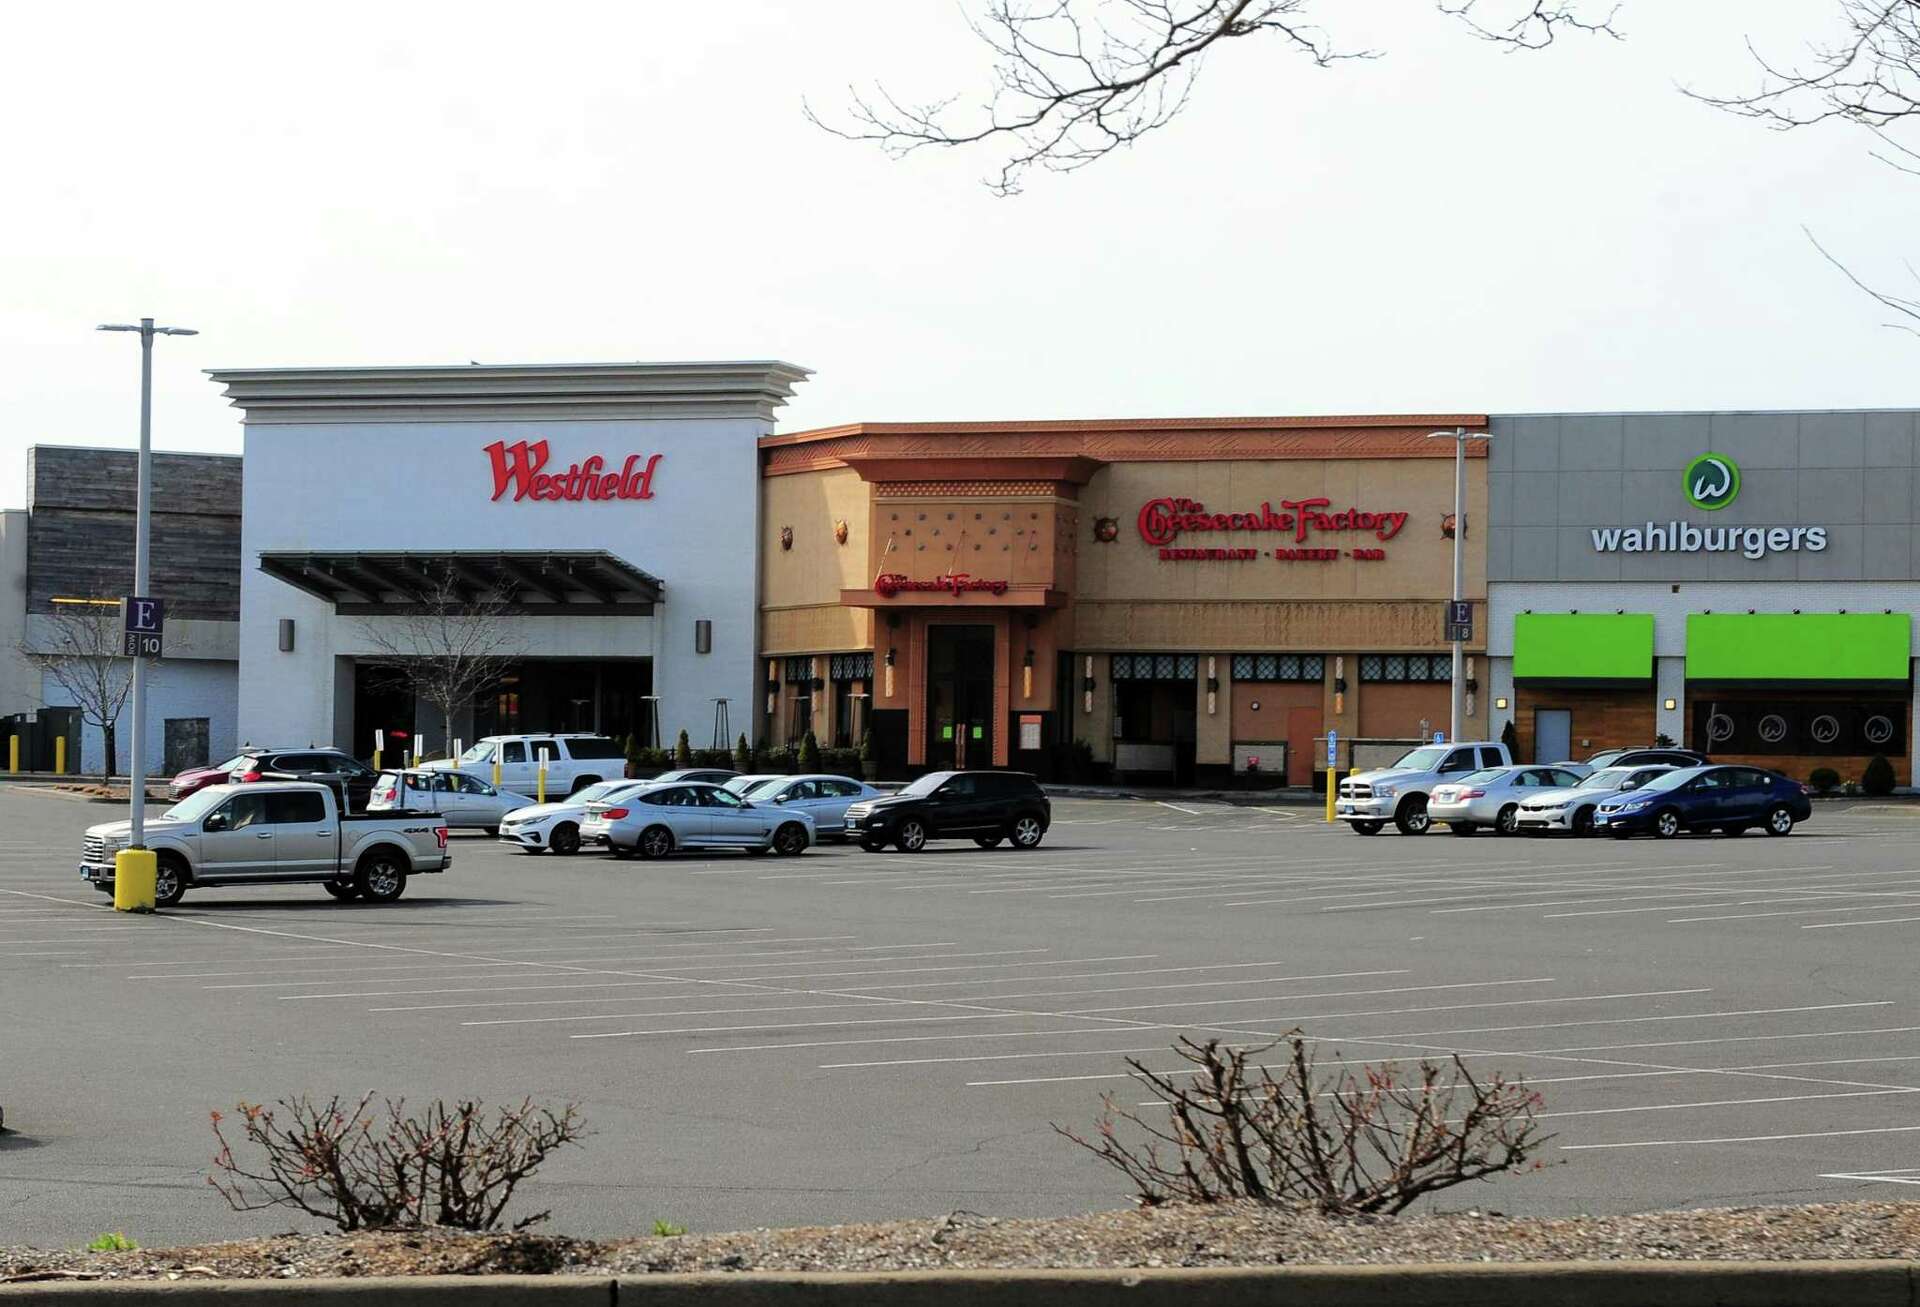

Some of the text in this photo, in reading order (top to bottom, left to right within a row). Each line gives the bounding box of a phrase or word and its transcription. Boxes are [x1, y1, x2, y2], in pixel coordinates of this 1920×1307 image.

[483, 439, 663, 502] Westfield
[1138, 497, 1408, 546] Cheesecake Factory
[1591, 521, 1827, 559] wahlburgers
[1353, 549, 1385, 561] BAR
[134, 601, 156, 630] E
[1455, 603, 1468, 622] E
[127, 633, 160, 656] ROW 10
